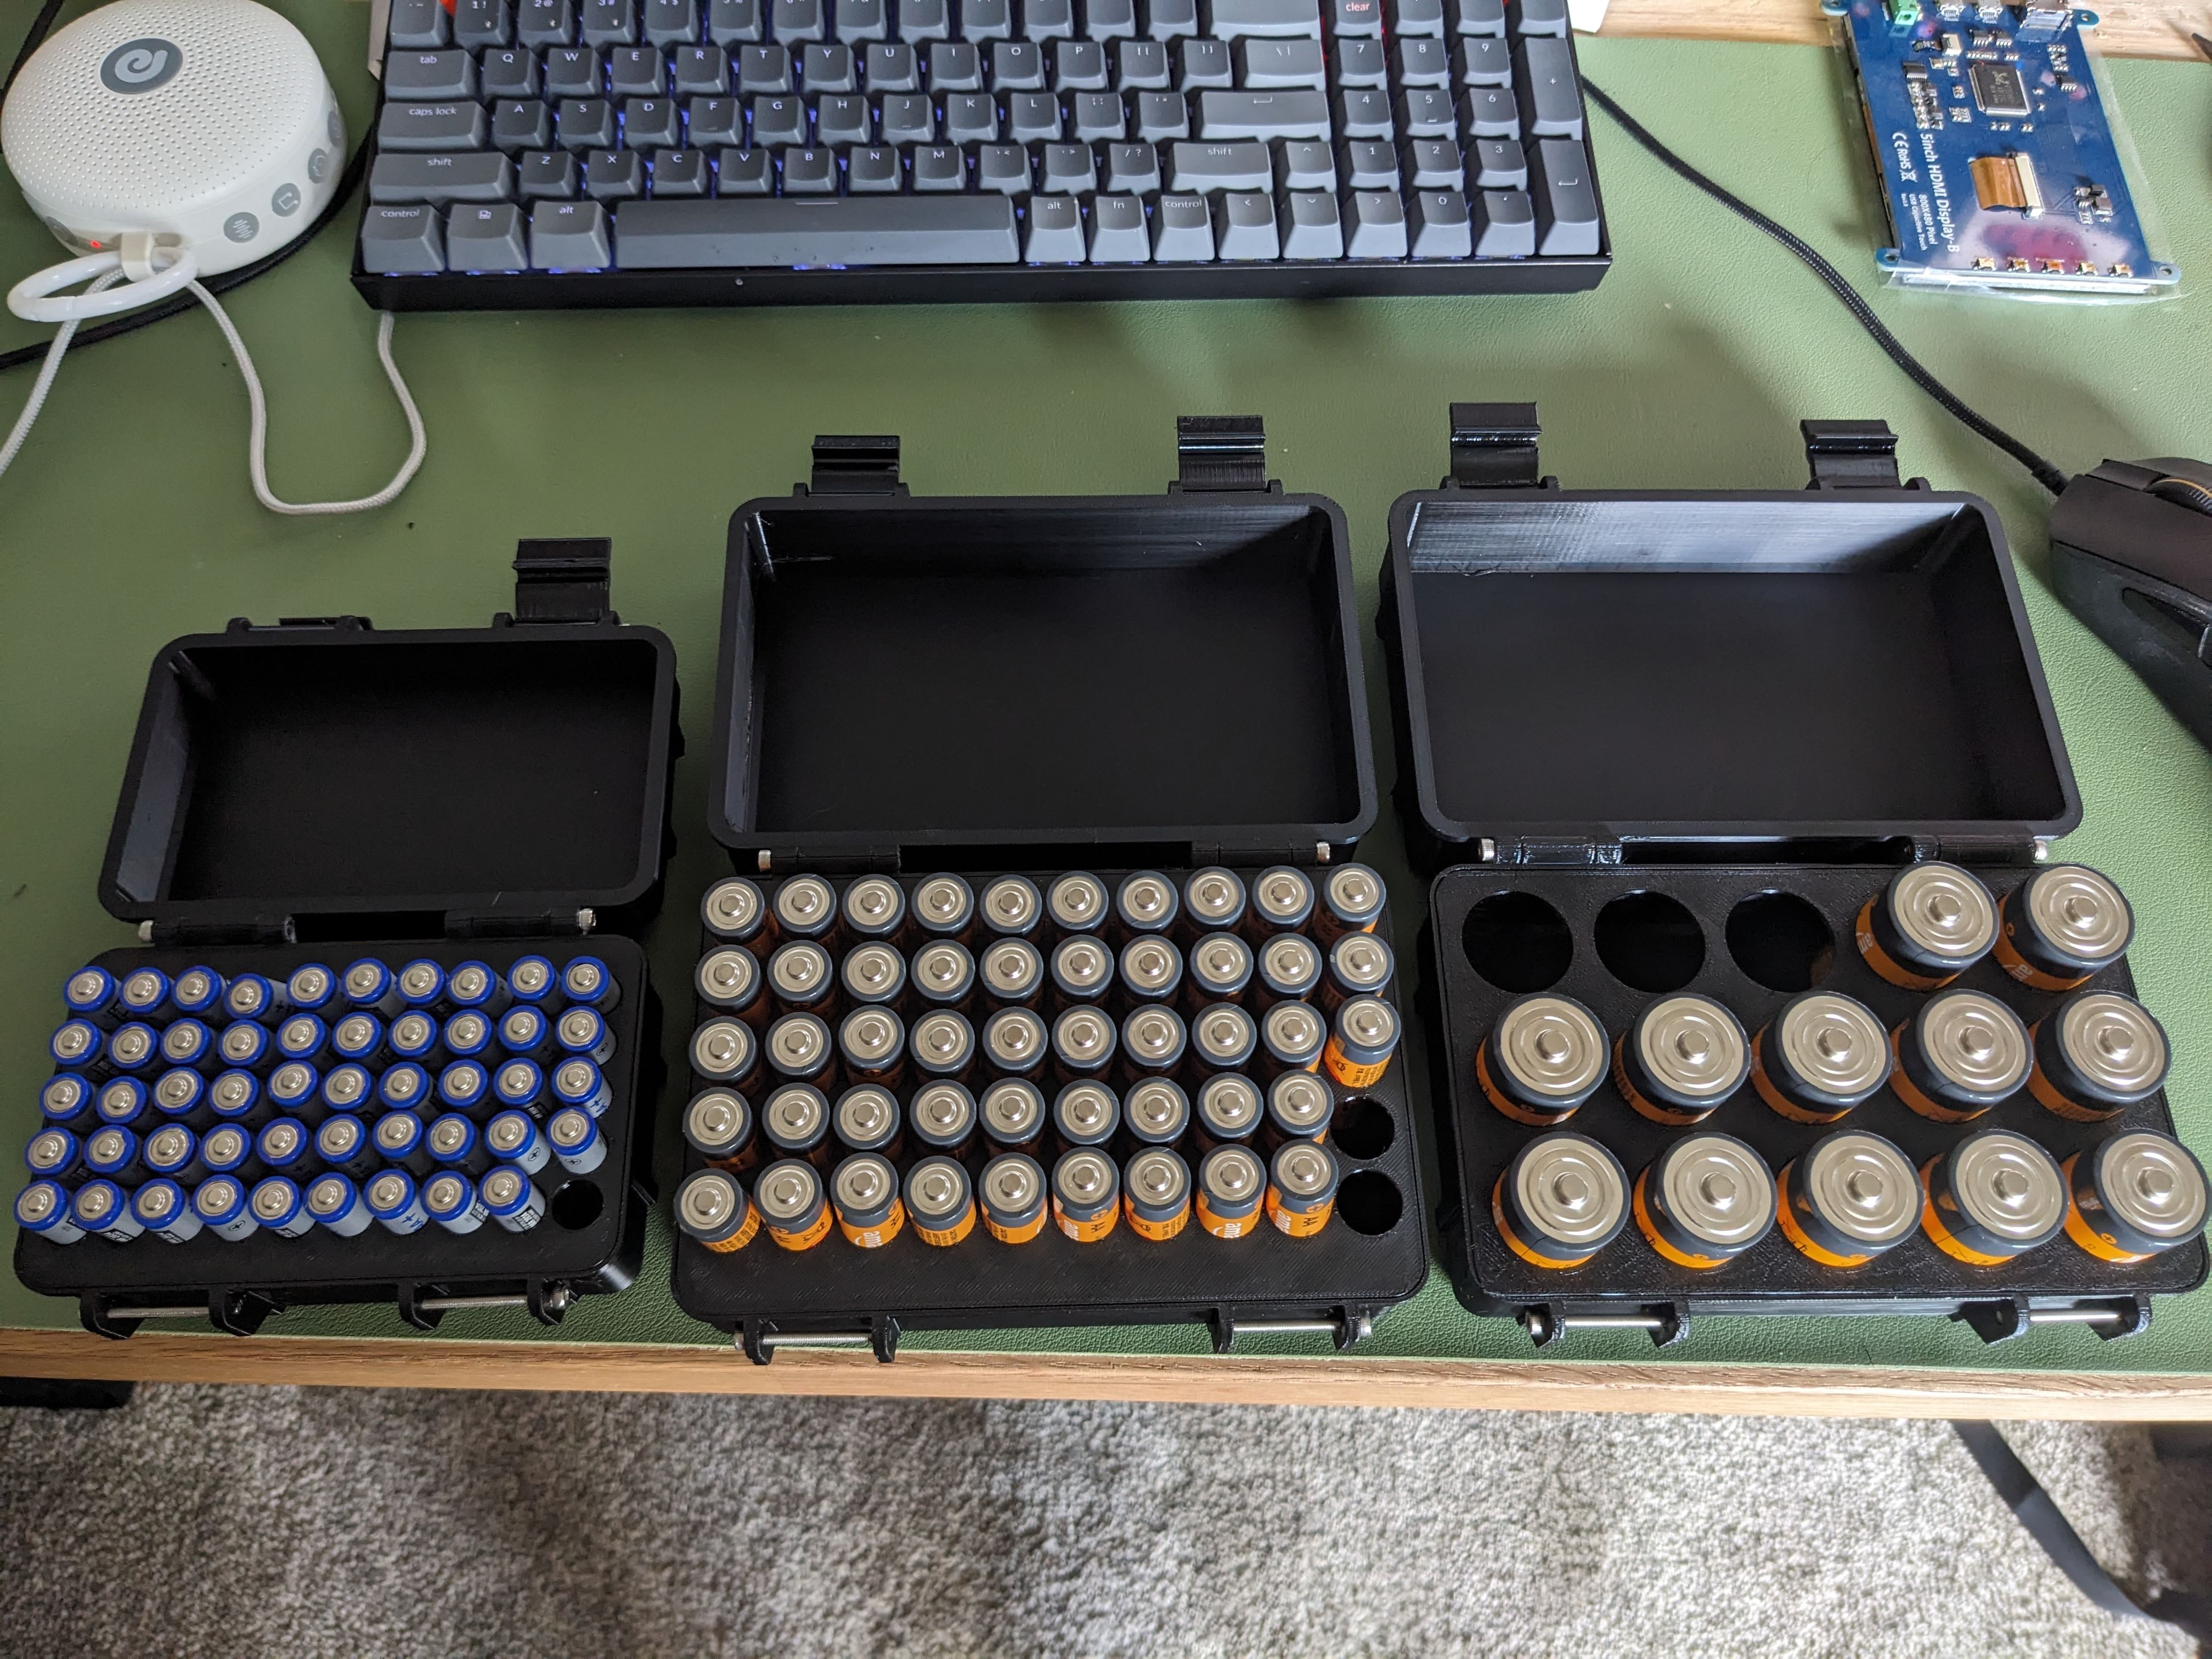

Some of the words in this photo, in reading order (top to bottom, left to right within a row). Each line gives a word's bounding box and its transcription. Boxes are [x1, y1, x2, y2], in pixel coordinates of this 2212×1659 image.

[1346, 2, 1369, 11] clear
[885, 48, 895, 57] U
[1011, 47, 1022, 55] O
[1075, 46, 1083, 54] P
[1357, 44, 1364, 53] 7
[1418, 44, 1426, 53] 8
[1482, 43, 1489, 53] 9
[502, 53, 514, 63] Q
[565, 52, 578, 61] W
[632, 52, 639, 61] E
[696, 51, 704, 59] R
[759, 50, 768, 59] T
[823, 49, 832, 58] Y
[420, 55, 437, 64] tab
[1030, 98, 1037, 108] L
[1362, 95, 1370, 104] 4
[1426, 95, 1432, 104] 5
[1488, 94, 1497, 103] 6
[644, 103, 654, 111] D
[709, 102, 718, 110] F
[772, 101, 782, 110] G
[837, 100, 847, 109] H
[904, 100, 910, 109] J
[967, 99, 975, 108] K
[409, 108, 433, 116] caps
[436, 106, 457, 115] lock
[514, 105, 524, 114] A
[579, 104, 586, 113] S
[1207, 146, 1232, 155] shift
[1369, 147, 1376, 155] 1
[1432, 146, 1440, 154] 2
[1496, 145, 1503, 154] 3
[1920, 133, 1939, 162] 5inch
[607, 155, 617, 163] X
[672, 154, 683, 163] C
[739, 153, 749, 161] V
[805, 153, 813, 161] B
[870, 151, 880, 160] N
[933, 150, 945, 159] M
[1897, 148, 1912, 170] RoHS
[427, 157, 453, 166] shift
[541, 156, 551, 164] Z
[1928, 165, 1947, 198] HDMI
[1165, 199, 1202, 208] control
[1909, 193, 1917, 207] USB
[1047, 201, 1062, 210] alt
[1113, 201, 1125, 210] fn
[381, 208, 420, 218] control
[558, 206, 574, 215] alt
[1911, 206, 1923, 233] Capacitive
[1936, 199, 1960, 252] Display-B
[1926, 227, 1939, 245] Pixel
[1917, 234, 1928, 251] Touch
